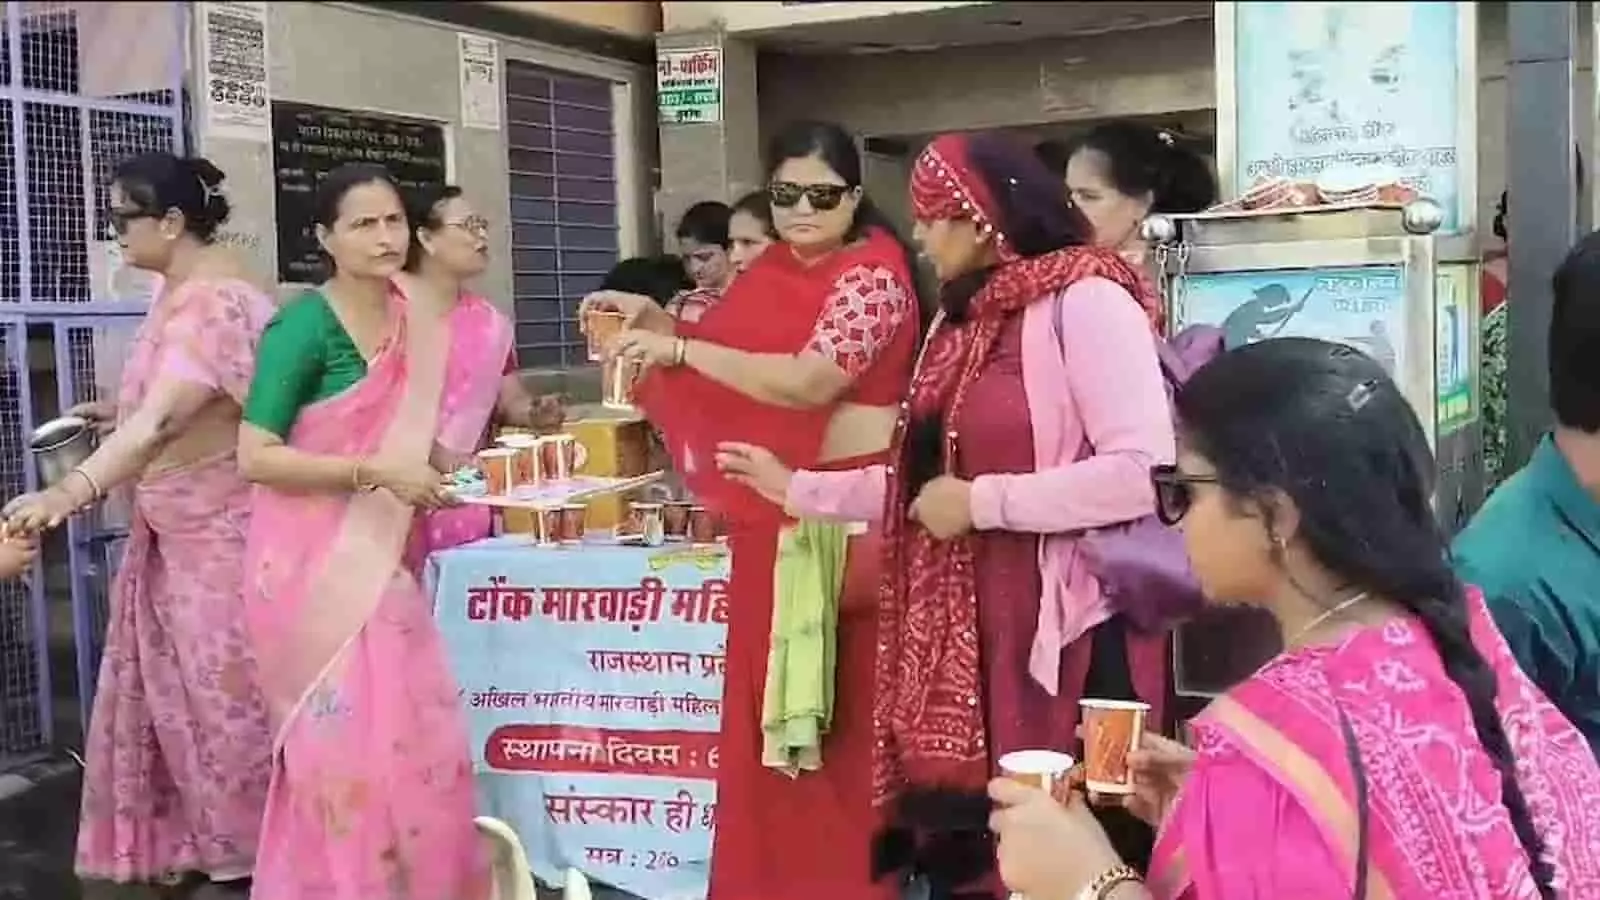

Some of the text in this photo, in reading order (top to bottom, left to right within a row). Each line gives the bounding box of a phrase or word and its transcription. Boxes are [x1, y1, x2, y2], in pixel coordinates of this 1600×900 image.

[467, 576, 535, 621] टोंक
[541, 577, 665, 632] मारवाड़ी
[587, 650, 691, 675] राजस्थान
[471, 685, 528, 708] अखिल
[502, 739, 600, 764] स्थापना
[607, 736, 680, 766] दिवस
[543, 785, 654, 825] संस्कार
[664, 788, 696, 833] ही
